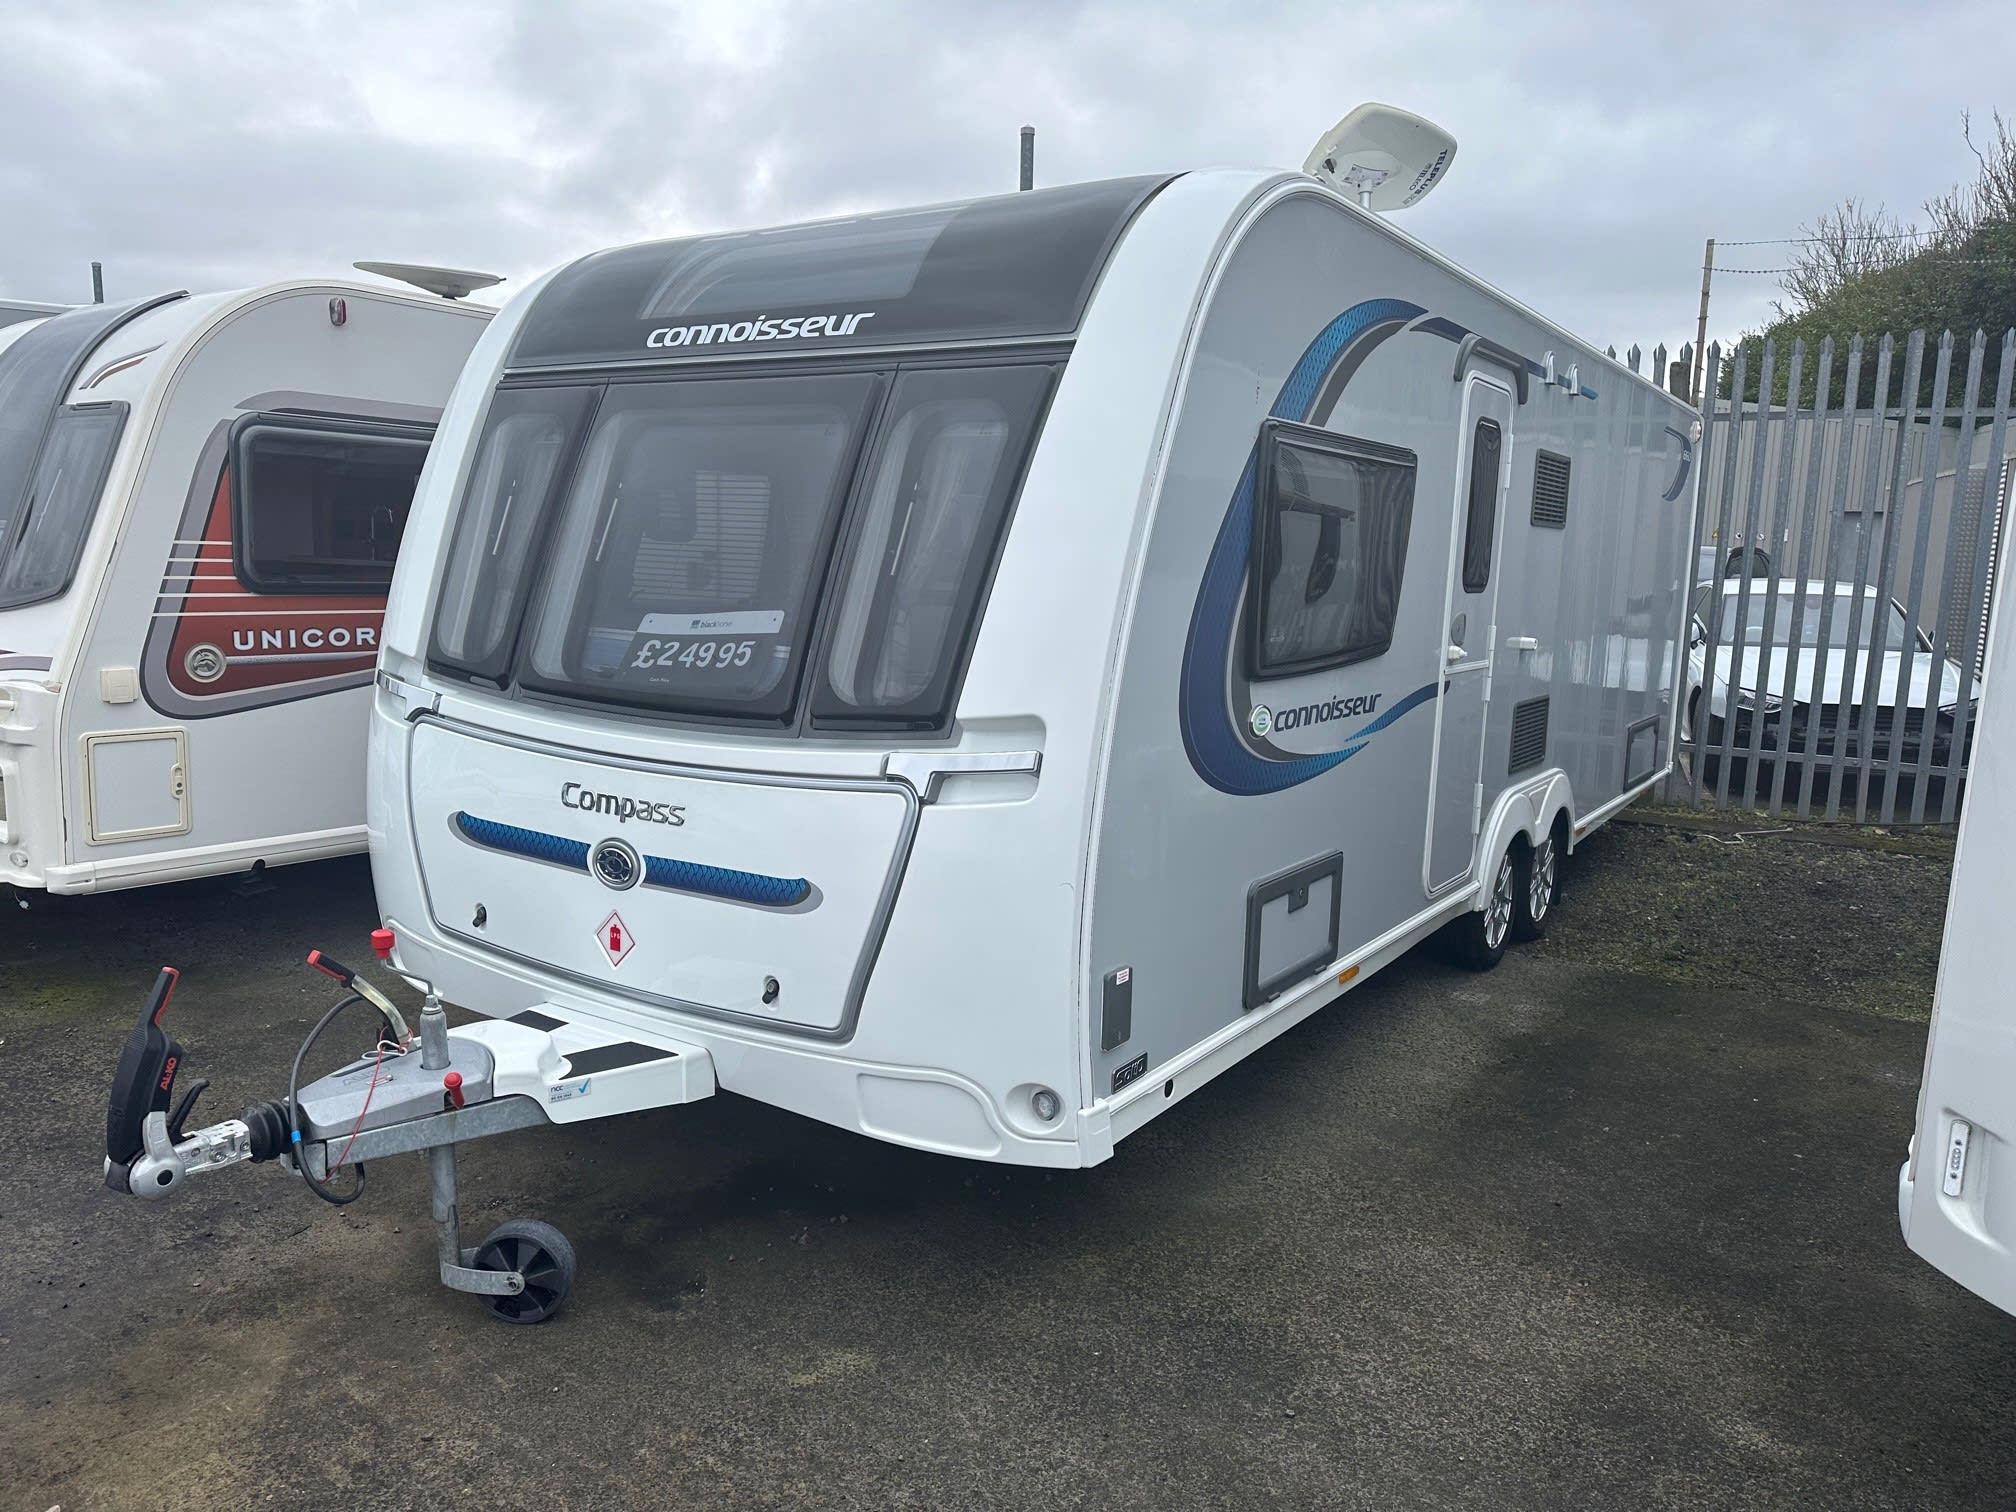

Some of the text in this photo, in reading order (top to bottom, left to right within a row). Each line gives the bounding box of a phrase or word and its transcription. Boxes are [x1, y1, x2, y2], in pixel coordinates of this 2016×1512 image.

[1415, 149, 1448, 195] TELEPLUS
[646, 312, 875, 348] connoisseur
[232, 627, 382, 650] UNICOR
[631, 639, 756, 668] £24995
[1274, 693, 1382, 732] connoisseur
[561, 781, 686, 827] Compass
